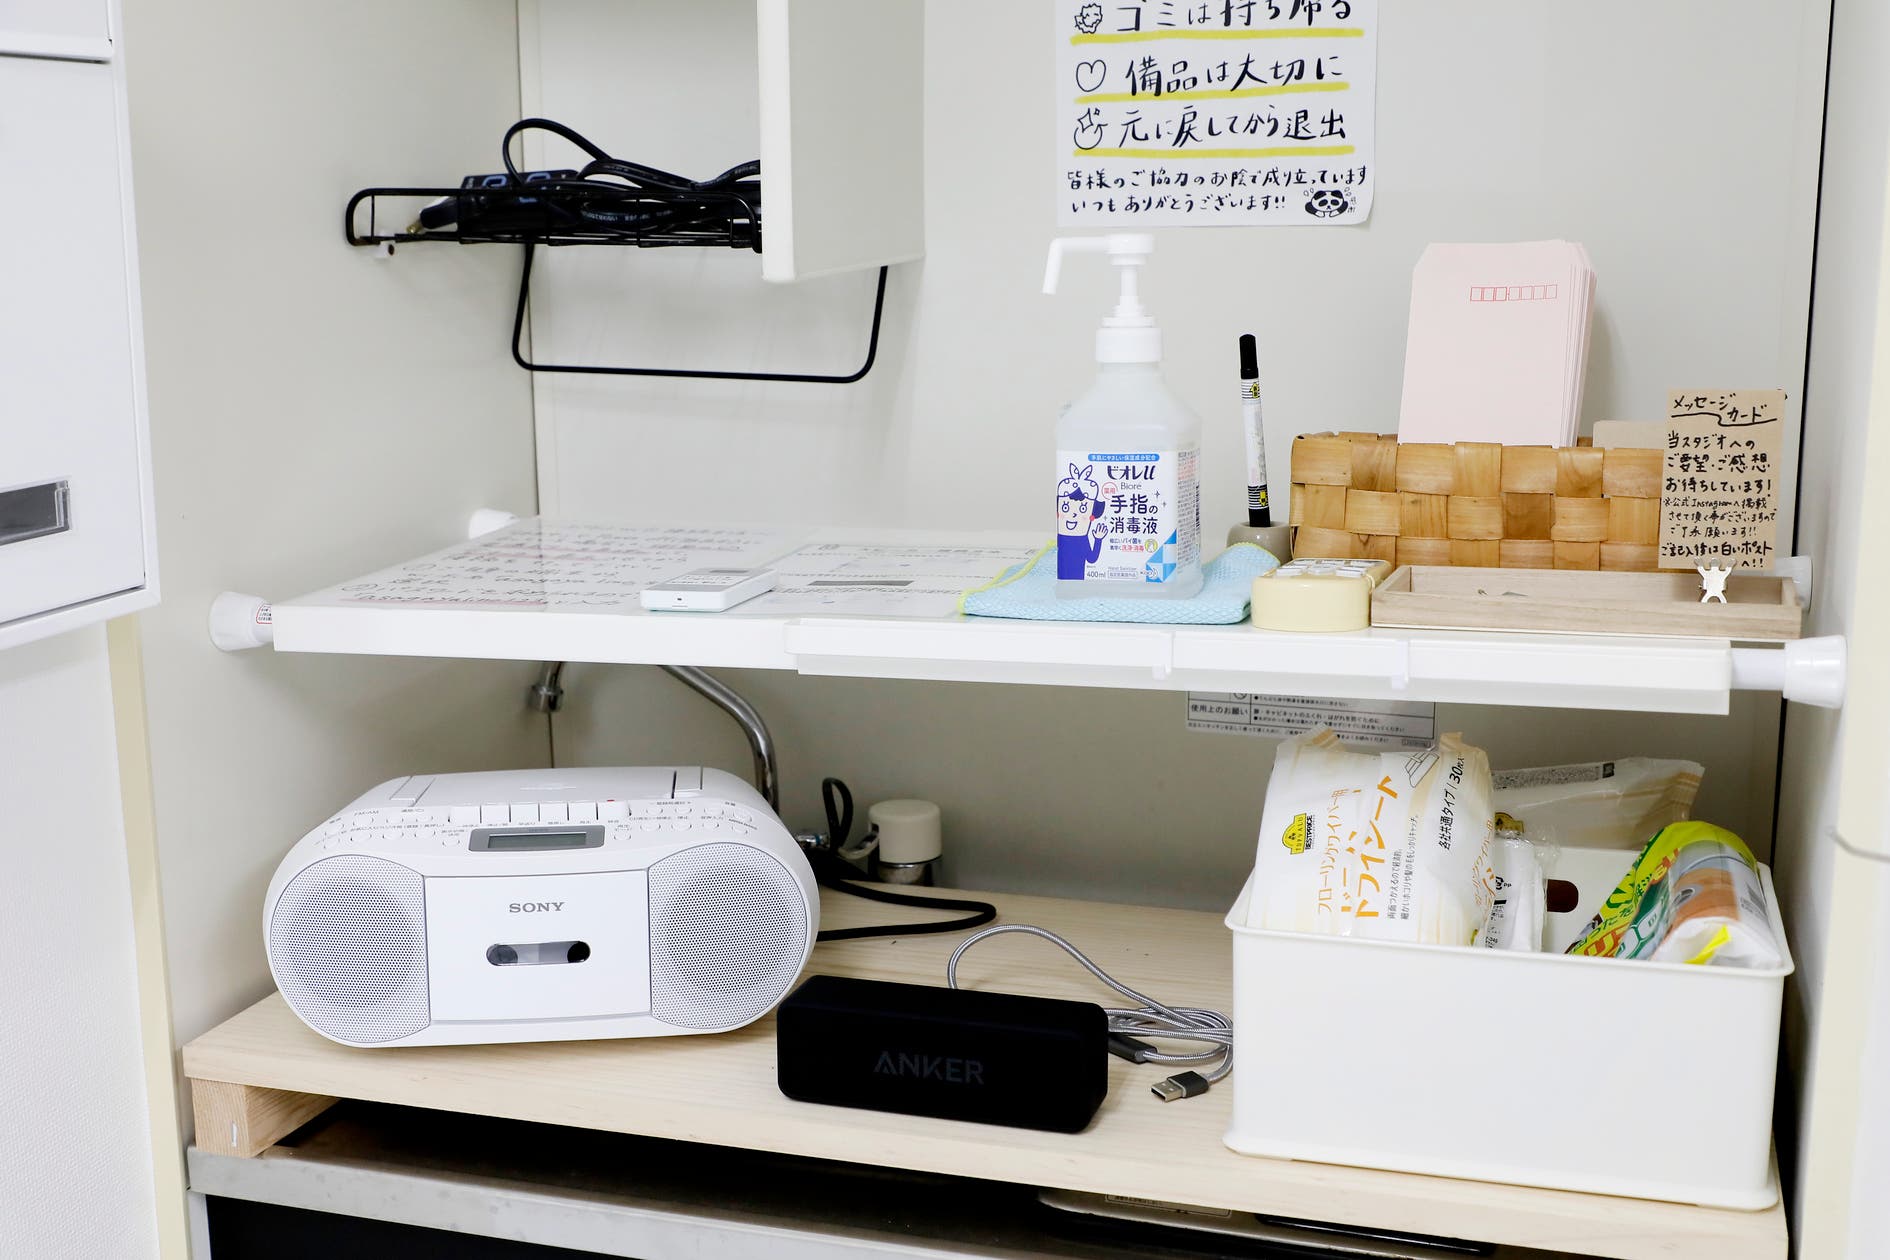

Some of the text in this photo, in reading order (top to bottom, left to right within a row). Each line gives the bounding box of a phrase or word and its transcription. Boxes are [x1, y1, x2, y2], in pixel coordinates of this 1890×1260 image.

[1125, 53, 1343, 97] 備品は大切に
[1118, 105, 1347, 148] 元に戻してから退出
[1067, 165, 1368, 190] 皆様のご協力のお陰で成り立っています
[1673, 393, 1736, 411] メッセージ
[1727, 404, 1768, 423] カード
[1668, 430, 1755, 450] 当スタジオへの
[1110, 494, 1158, 514] 手指の
[1109, 517, 1158, 534] 消毒液
[1661, 541, 1773, 557] ご記入後は白いポスト
[1191, 703, 1248, 715] 使用上のお願い
[1438, 788, 1456, 850] 各社共通タイプ
[509, 901, 565, 913] SONY
[873, 1050, 985, 1085] ANKER
